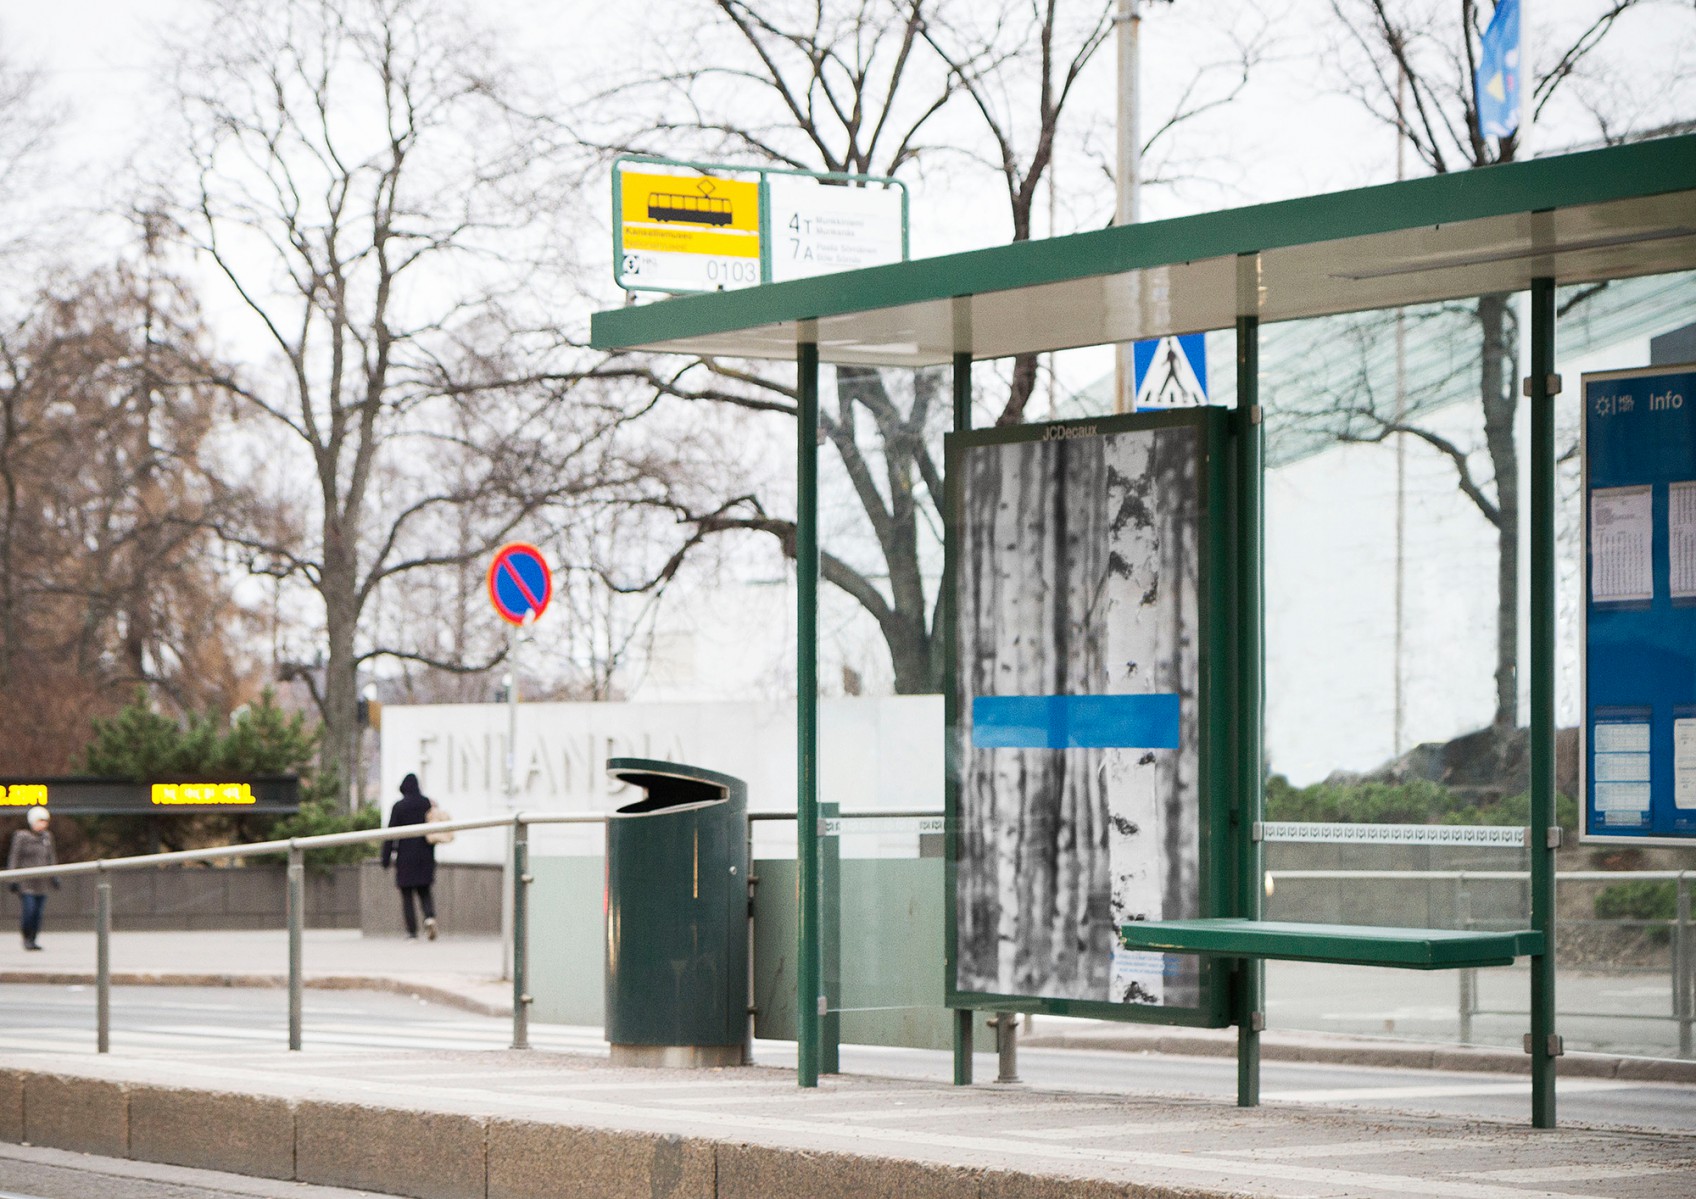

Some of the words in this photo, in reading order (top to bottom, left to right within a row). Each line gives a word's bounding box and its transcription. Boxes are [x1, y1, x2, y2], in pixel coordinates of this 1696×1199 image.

[707, 260, 756, 282] 0103
[1650, 390, 1683, 410] Info
[1042, 424, 1098, 442] JCDecaux
